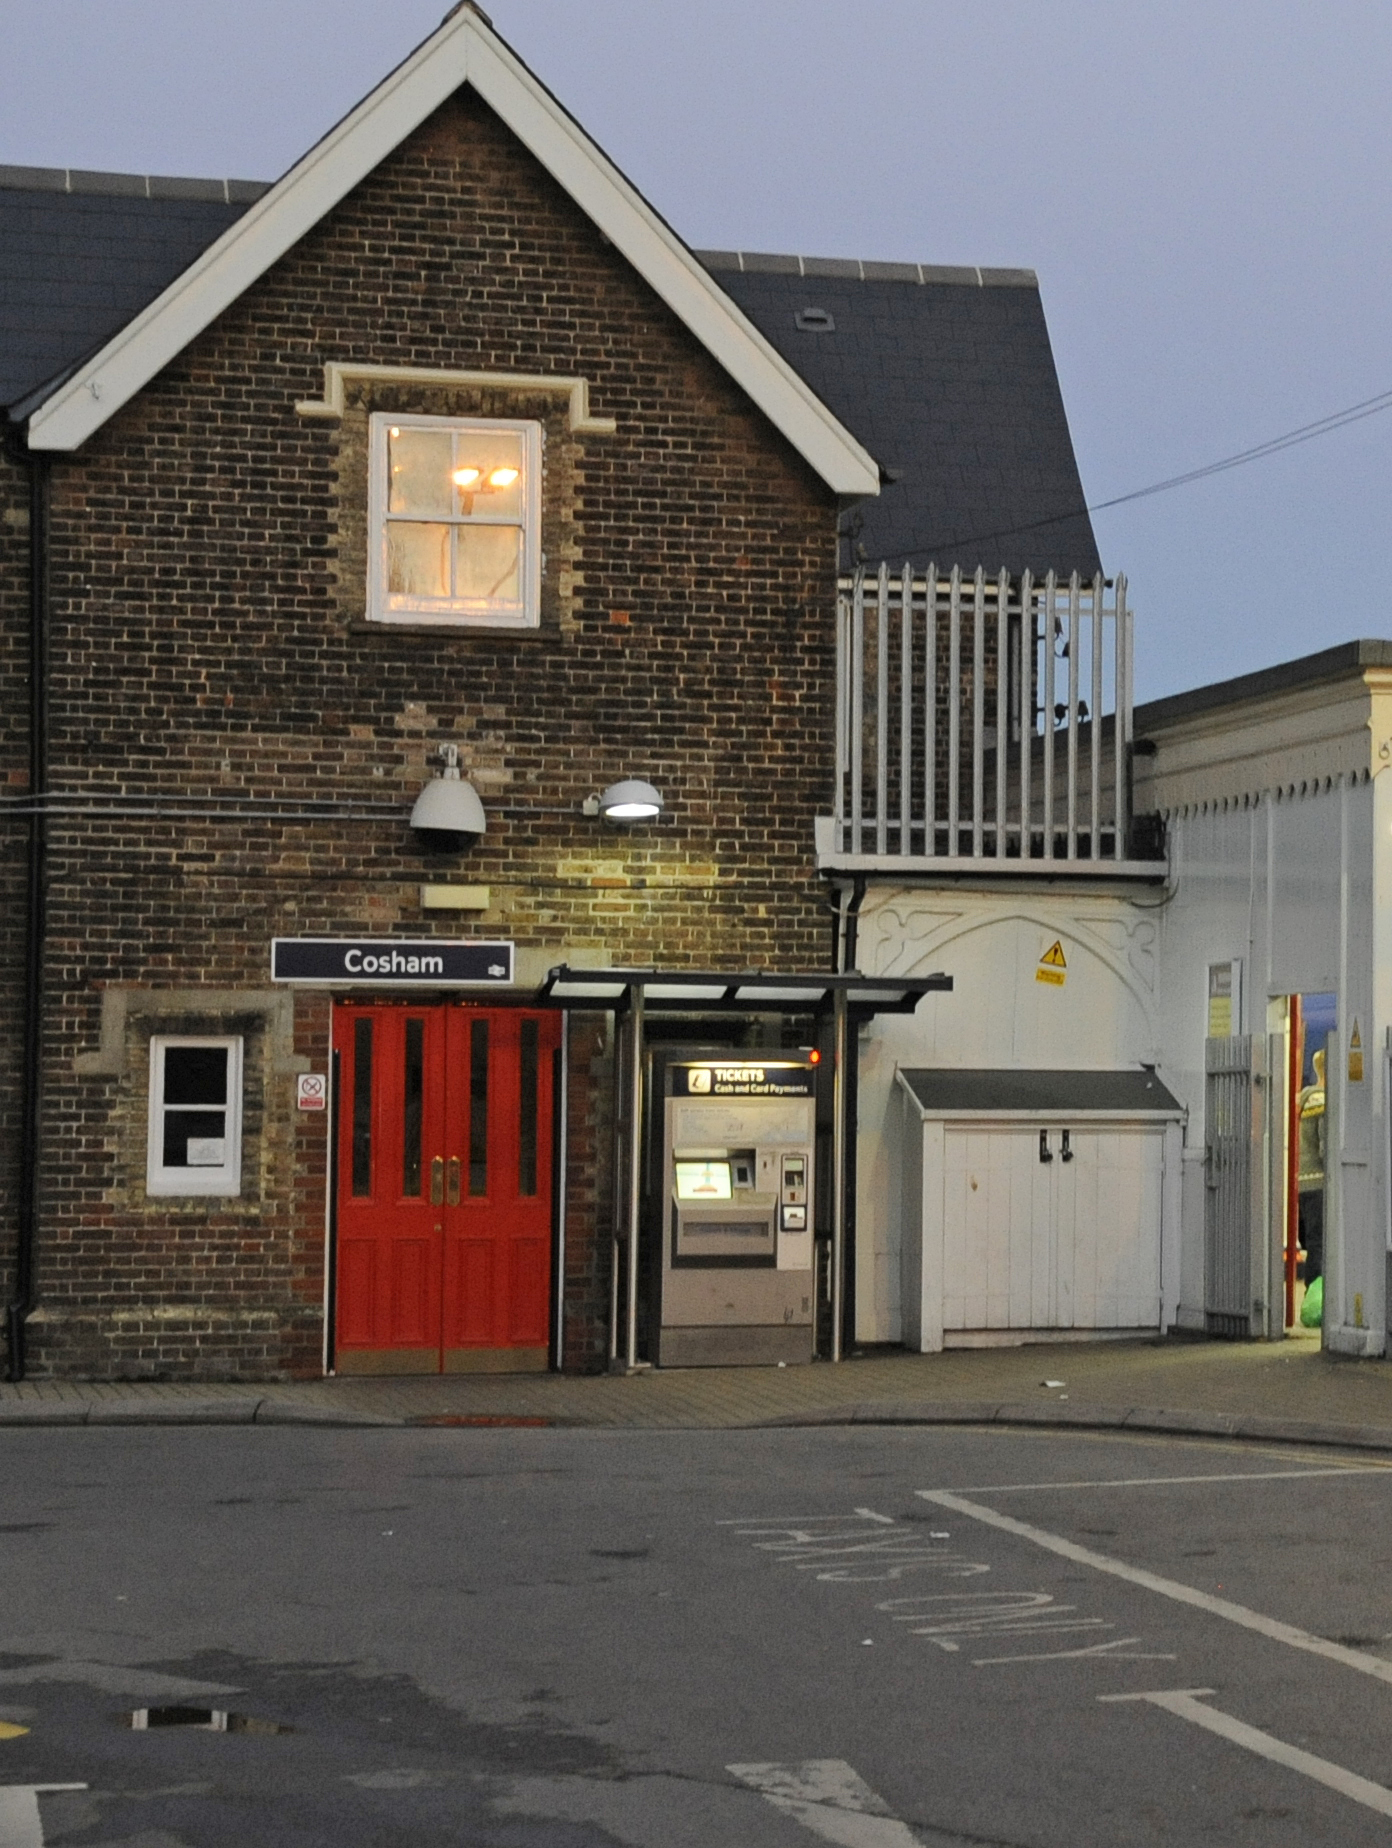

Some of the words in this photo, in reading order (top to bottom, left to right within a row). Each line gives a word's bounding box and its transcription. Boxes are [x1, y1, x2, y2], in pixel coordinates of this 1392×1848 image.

[345, 949, 443, 974] Cosham
[714, 1069, 765, 1082] TICKETS
[714, 1083, 734, 1094] Cash
[735, 1084, 749, 1094] and
[752, 1084, 769, 1094] Card
[770, 1084, 808, 1095] Payments
[714, 1506, 991, 1582] TAXIS
[874, 1591, 1178, 1666] ONLY
